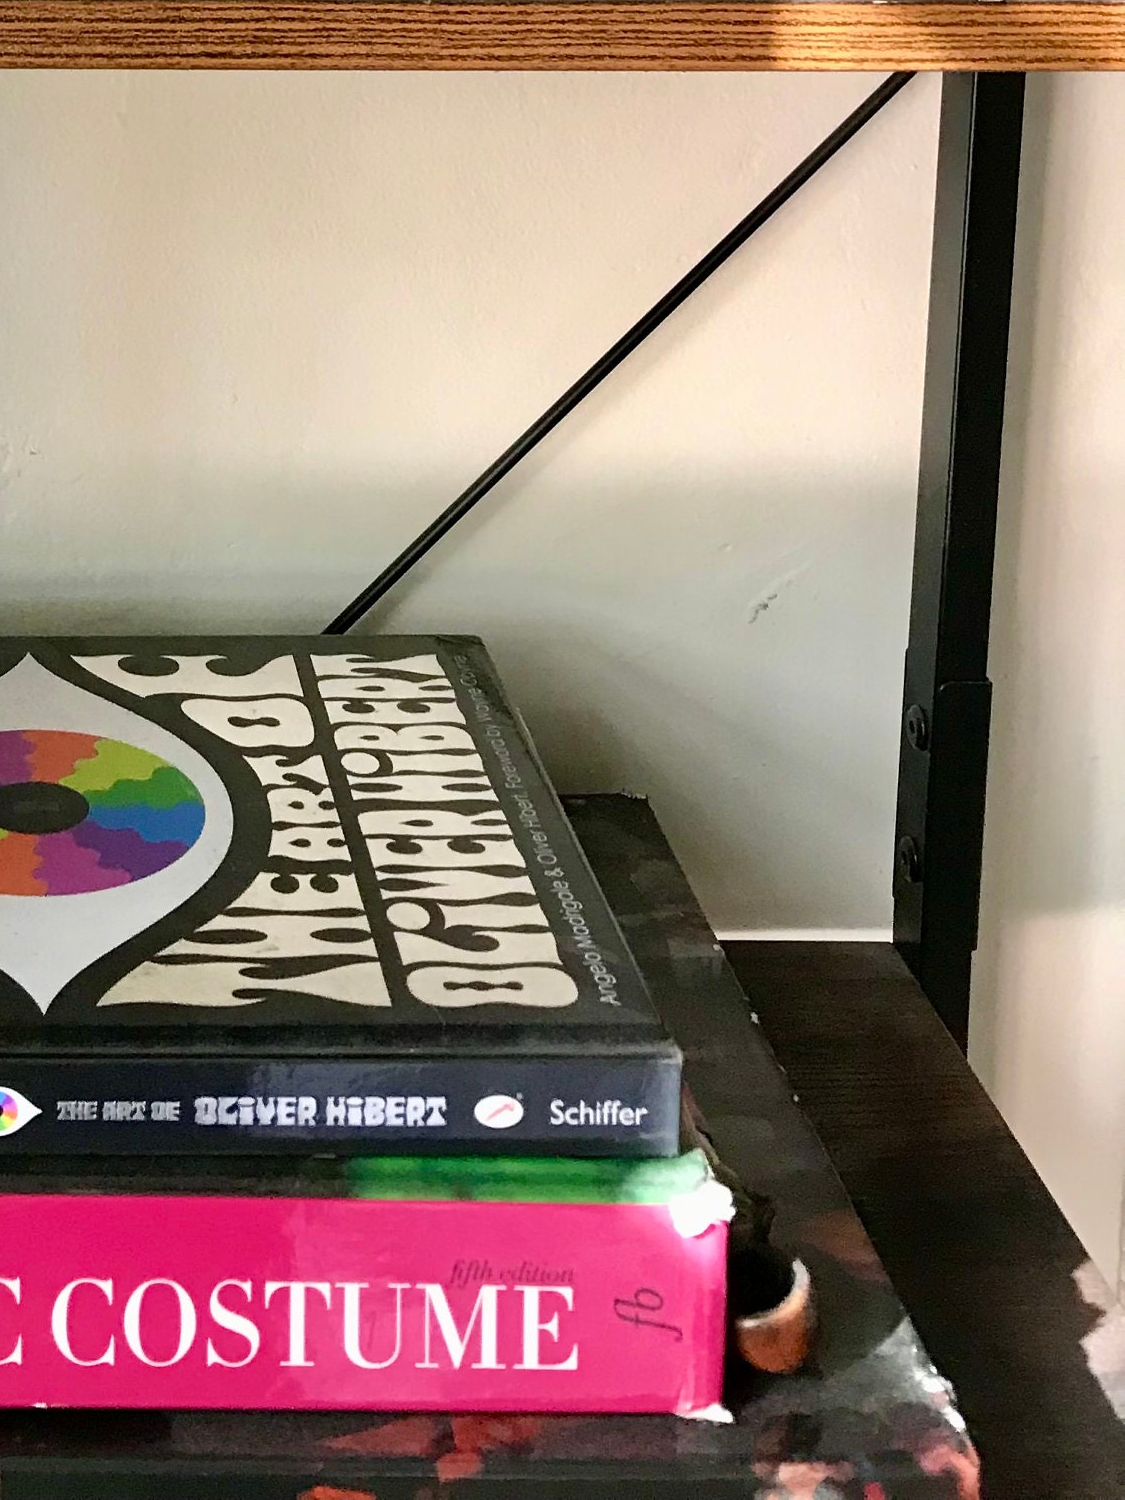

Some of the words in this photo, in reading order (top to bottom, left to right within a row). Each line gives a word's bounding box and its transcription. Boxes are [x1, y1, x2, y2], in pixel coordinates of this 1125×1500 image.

[71, 654, 316, 748] OF
[484, 726, 502, 740] by
[491, 740, 524, 788] Foreword
[244, 755, 354, 863] ART
[530, 830, 557, 865] Oliver
[545, 867, 564, 878] &
[96, 871, 392, 1007] THE
[550, 881, 596, 949] Madrigale
[583, 952, 622, 1006] Angelo
[57, 1101, 97, 1120] THE
[102, 1101, 146, 1121] ART
[151, 1101, 180, 1121] OF
[549, 1098, 649, 1126] Schiffer
[449, 1260, 493, 1288] fifth
[499, 1261, 575, 1283] edition
[51, 1277, 578, 1371] COSTUME
[613, 1287, 683, 1342] fb
